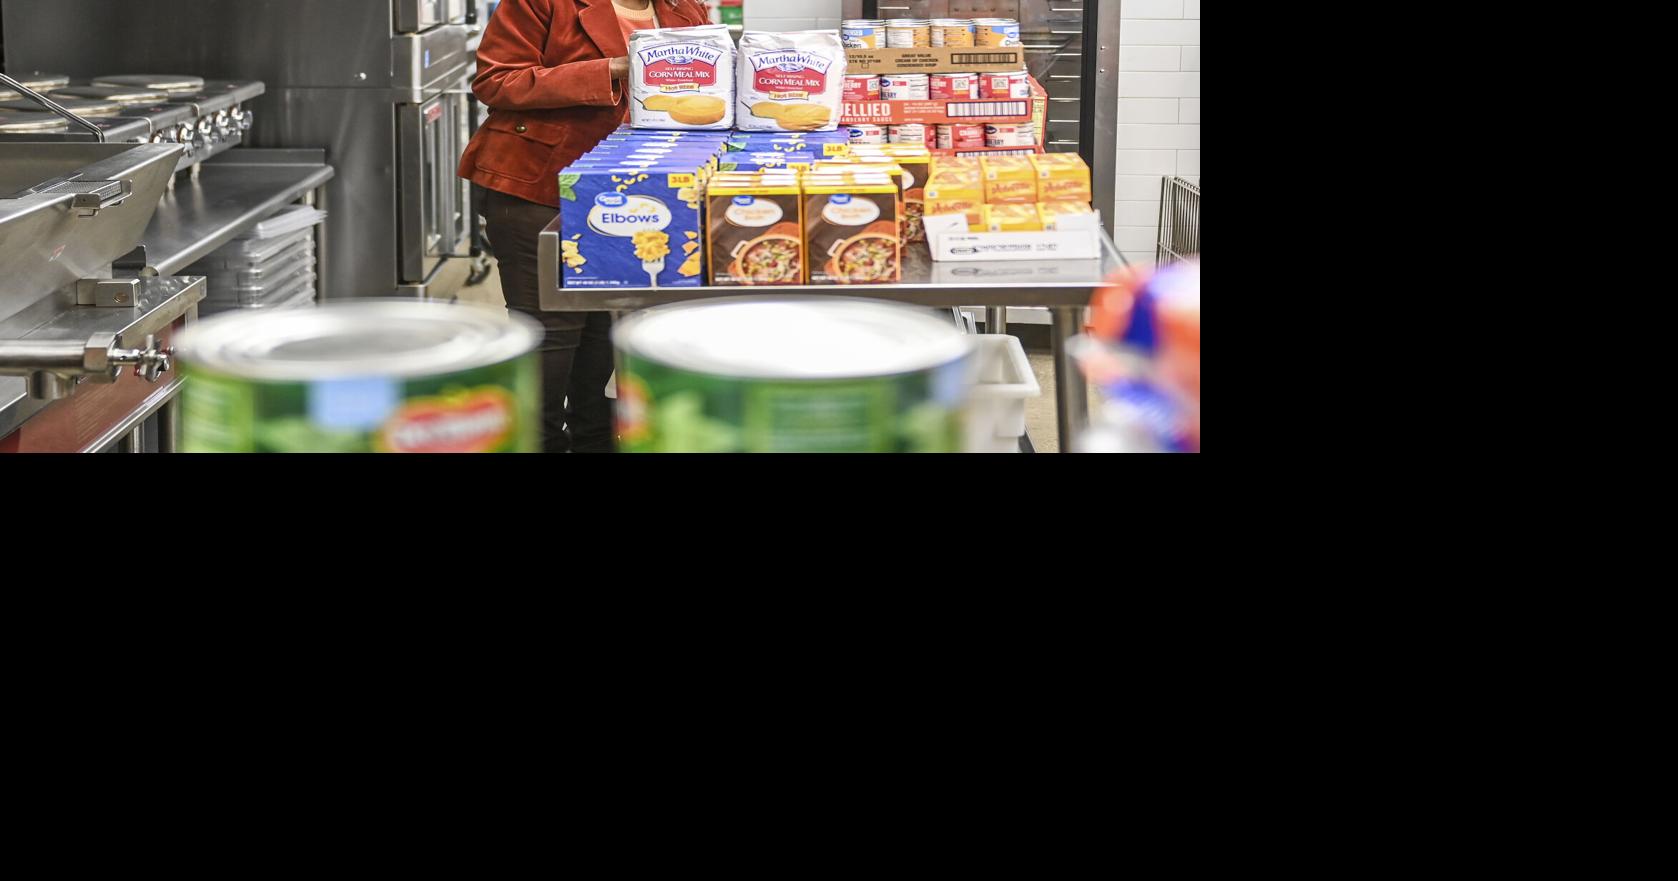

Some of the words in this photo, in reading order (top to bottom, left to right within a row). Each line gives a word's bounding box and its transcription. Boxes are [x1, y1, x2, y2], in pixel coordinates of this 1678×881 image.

[646, 47, 684, 62] Martha
[685, 46, 715, 60] White
[758, 54, 796, 68] Martha
[648, 70, 674, 78] CORN
[674, 70, 695, 78] MEAL
[695, 70, 711, 78] MIX
[758, 77, 784, 85] CORN
[783, 78, 804, 86] MEAL
[805, 79, 821, 87] MIX
[601, 212, 660, 224] Elbows
